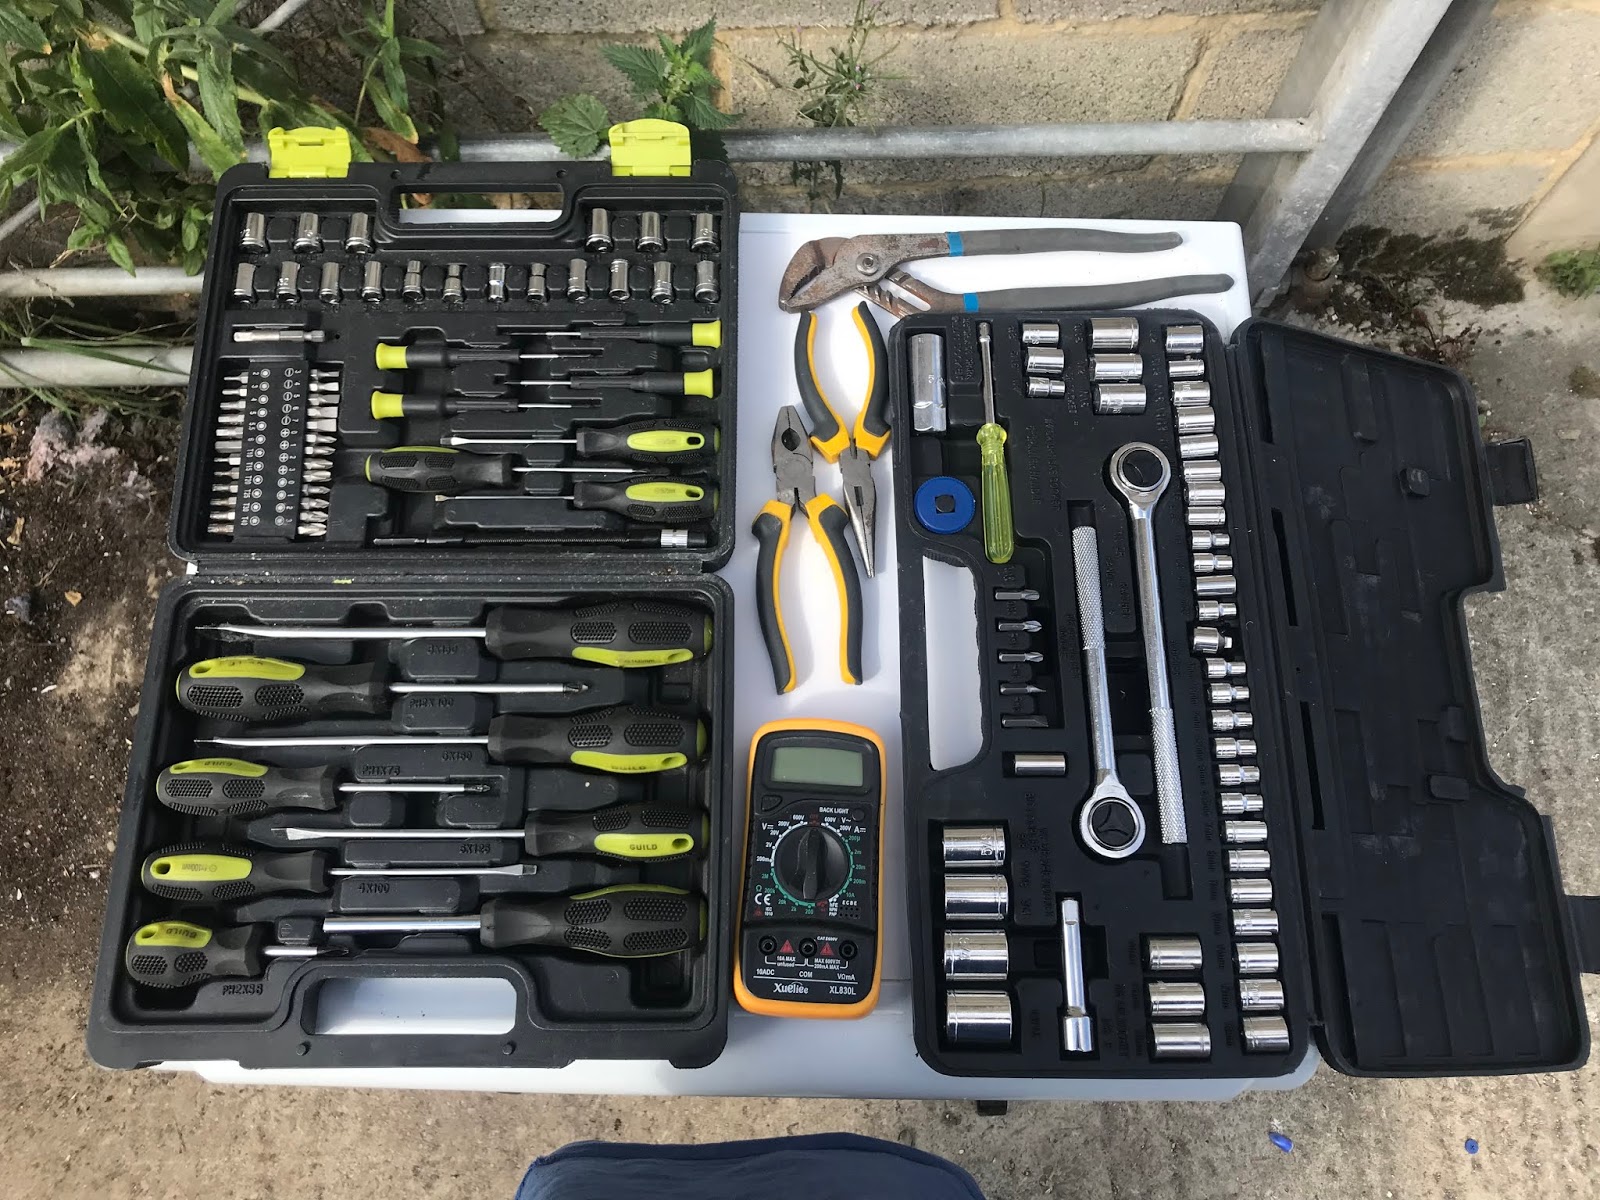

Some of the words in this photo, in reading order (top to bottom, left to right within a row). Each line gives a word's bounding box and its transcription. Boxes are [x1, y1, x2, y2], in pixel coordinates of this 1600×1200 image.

[629, 843, 658, 851] GUILD
[358, 882, 390, 894] 4X100
[755, 893, 771, 906] CE
[166, 928, 198, 939] GUILD
[829, 986, 857, 995] XL830L
